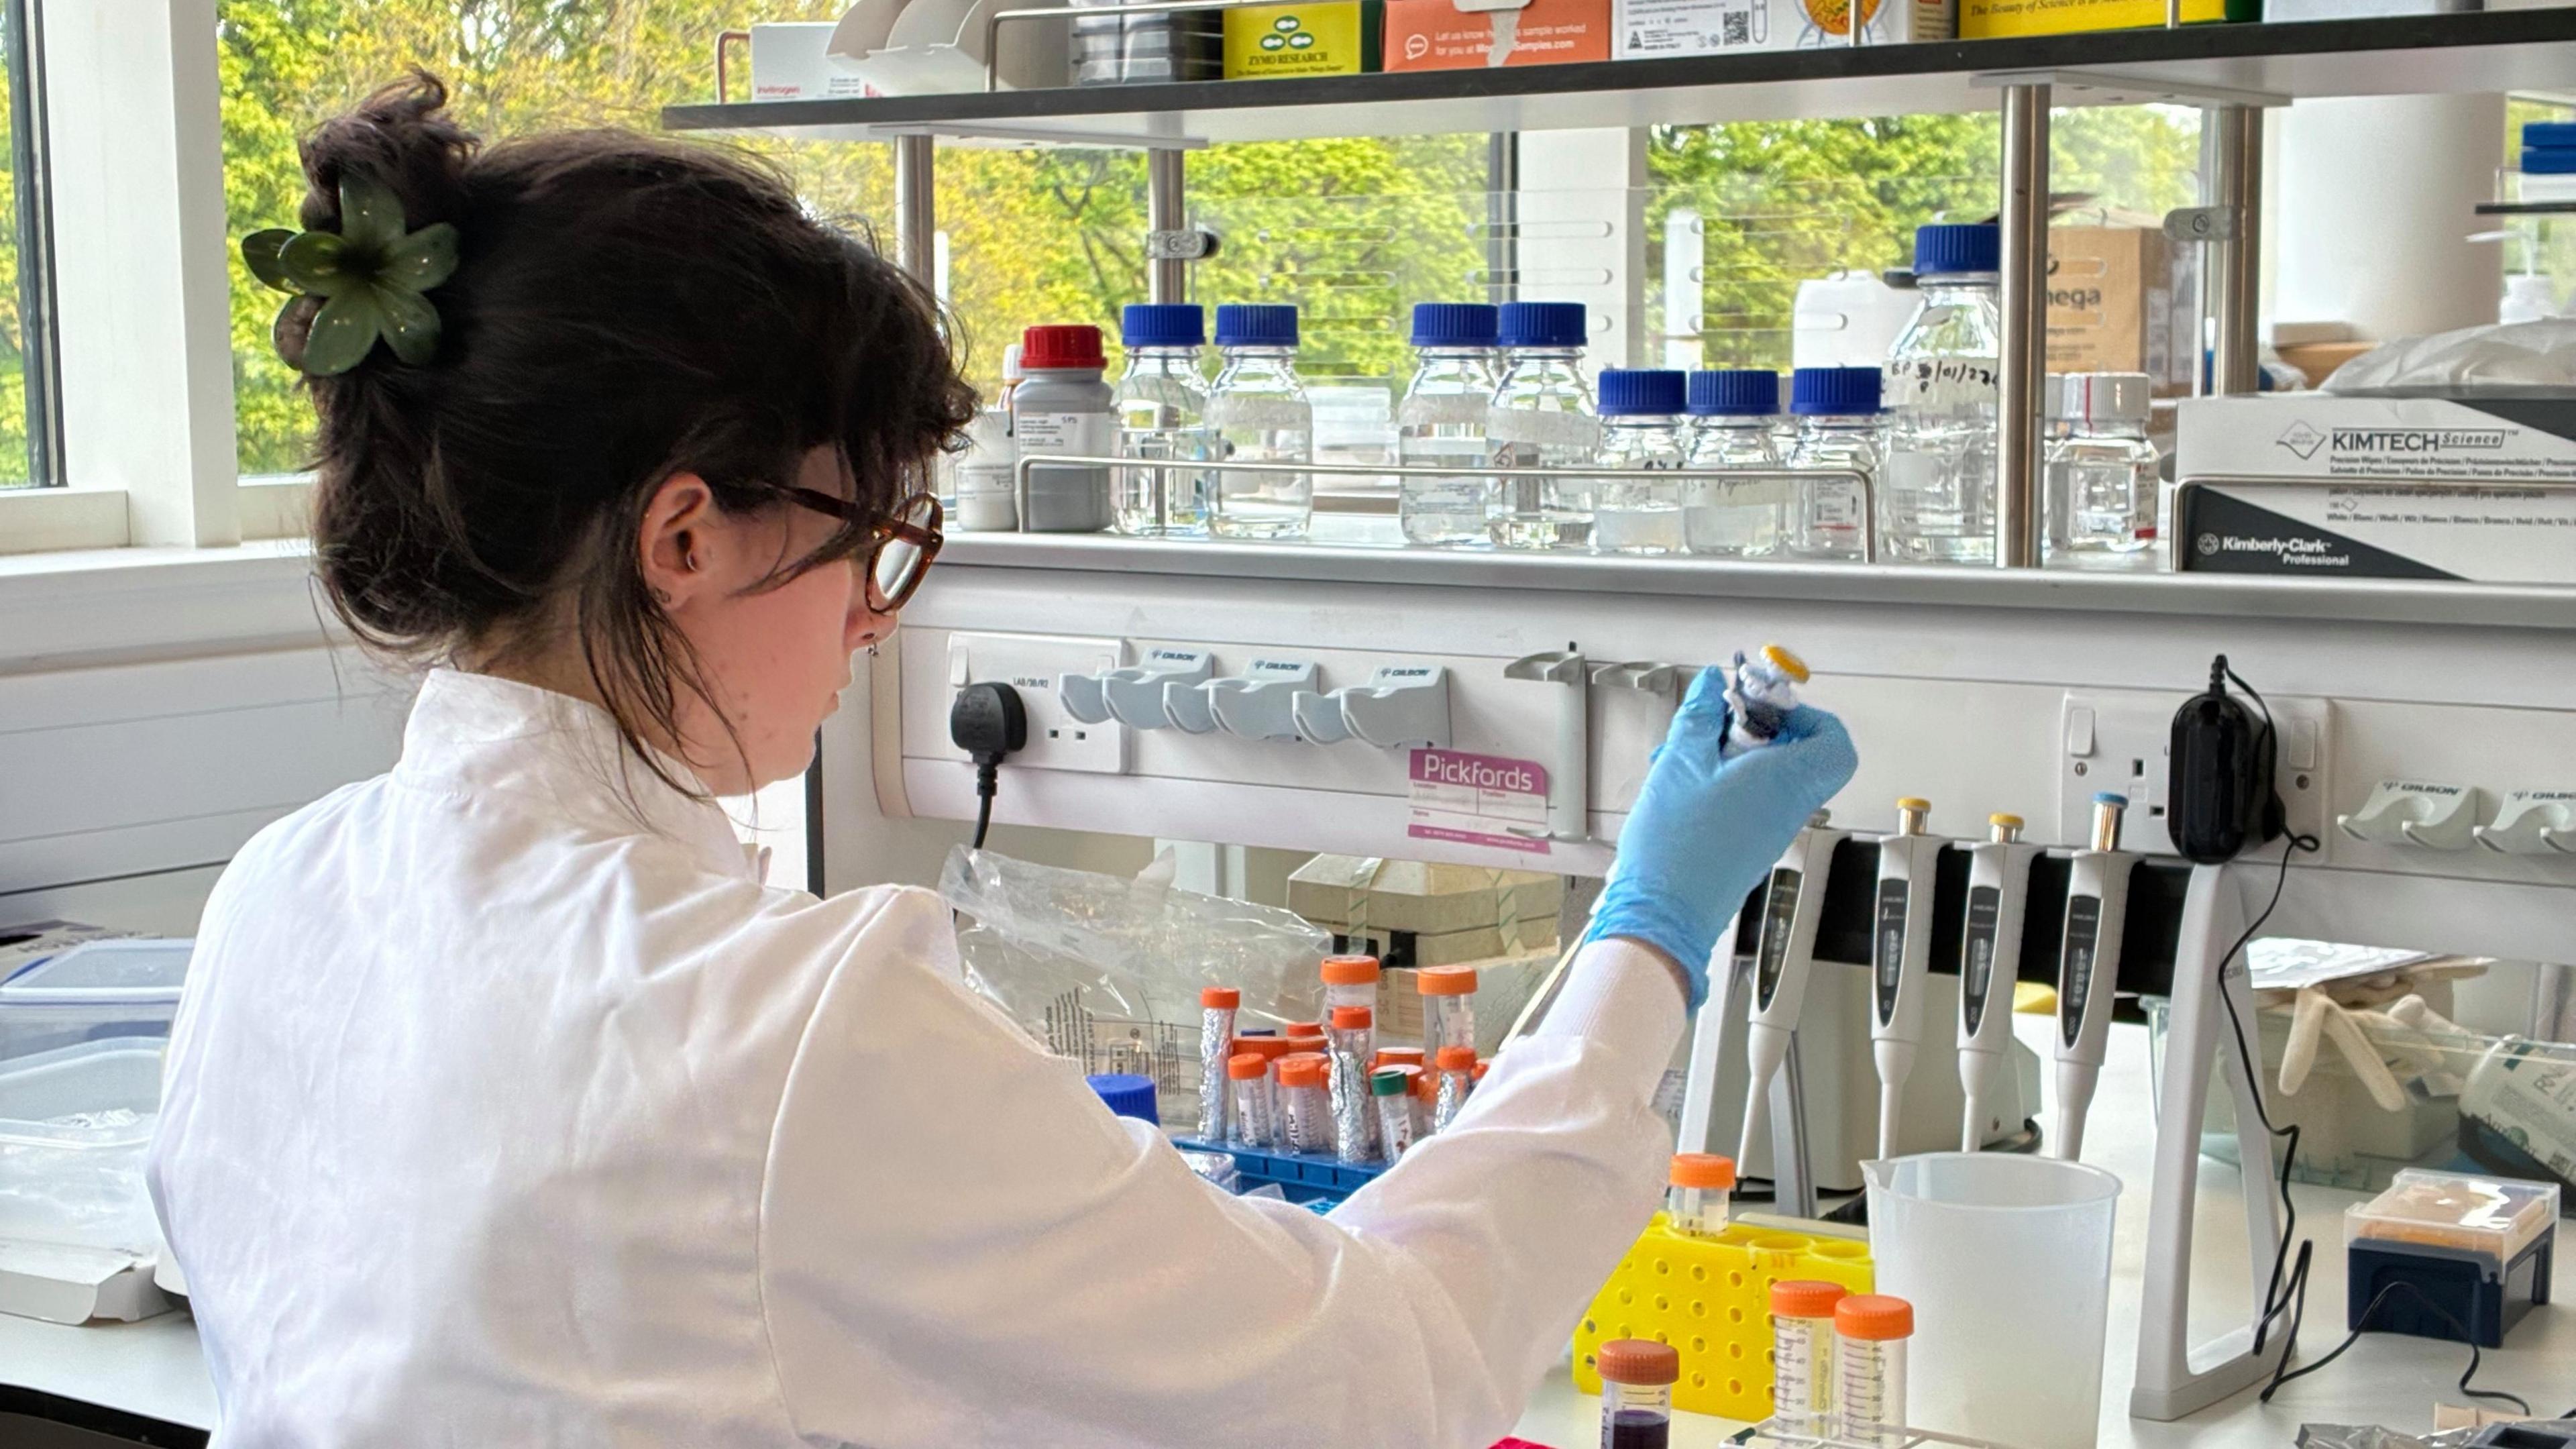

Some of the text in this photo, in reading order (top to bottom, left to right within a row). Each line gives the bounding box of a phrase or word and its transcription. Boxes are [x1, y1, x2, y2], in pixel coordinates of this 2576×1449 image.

[1248, 52, 1328, 66] ZYMO RESEARCH
[2332, 432, 2439, 451] KIMTECH
[2442, 432, 2500, 445] Science
[2222, 536, 2326, 555] Kimberly-Clark
[2283, 553, 2349, 566] Professional
[1424, 753, 1534, 792] Pickfords
[2400, 784, 2461, 796] GILSON
